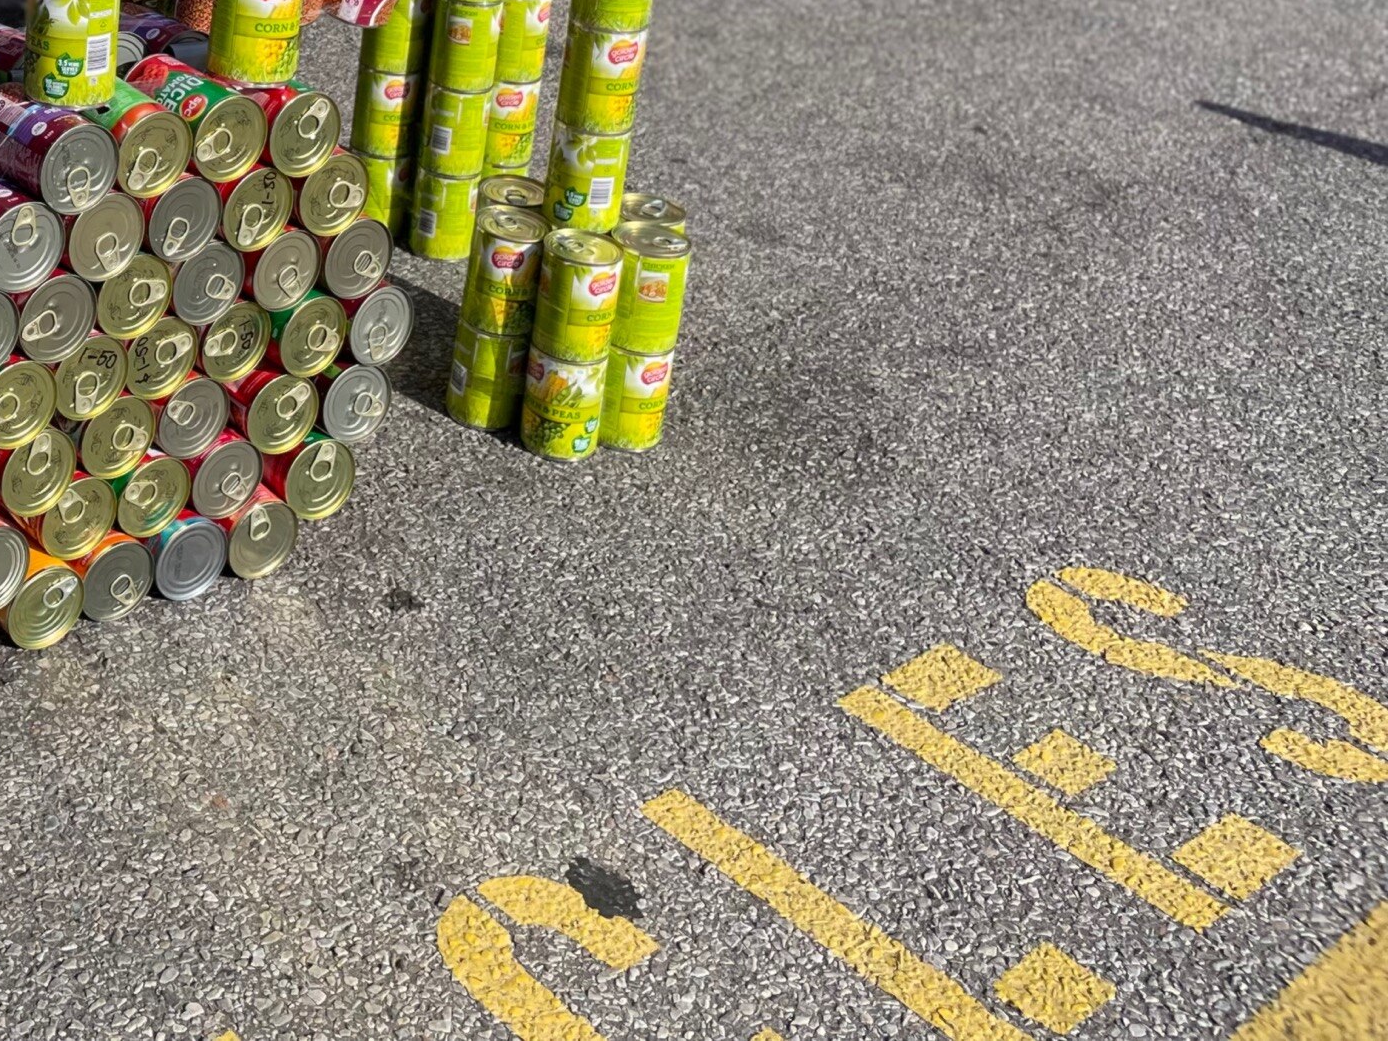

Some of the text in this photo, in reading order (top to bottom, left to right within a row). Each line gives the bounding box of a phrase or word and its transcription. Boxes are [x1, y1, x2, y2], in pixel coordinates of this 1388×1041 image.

[254, 23, 288, 33] CORN
[163, 76, 205, 112] DICE
[78, 347, 117, 369] 1-50
[554, 408, 581, 421] PEAS
